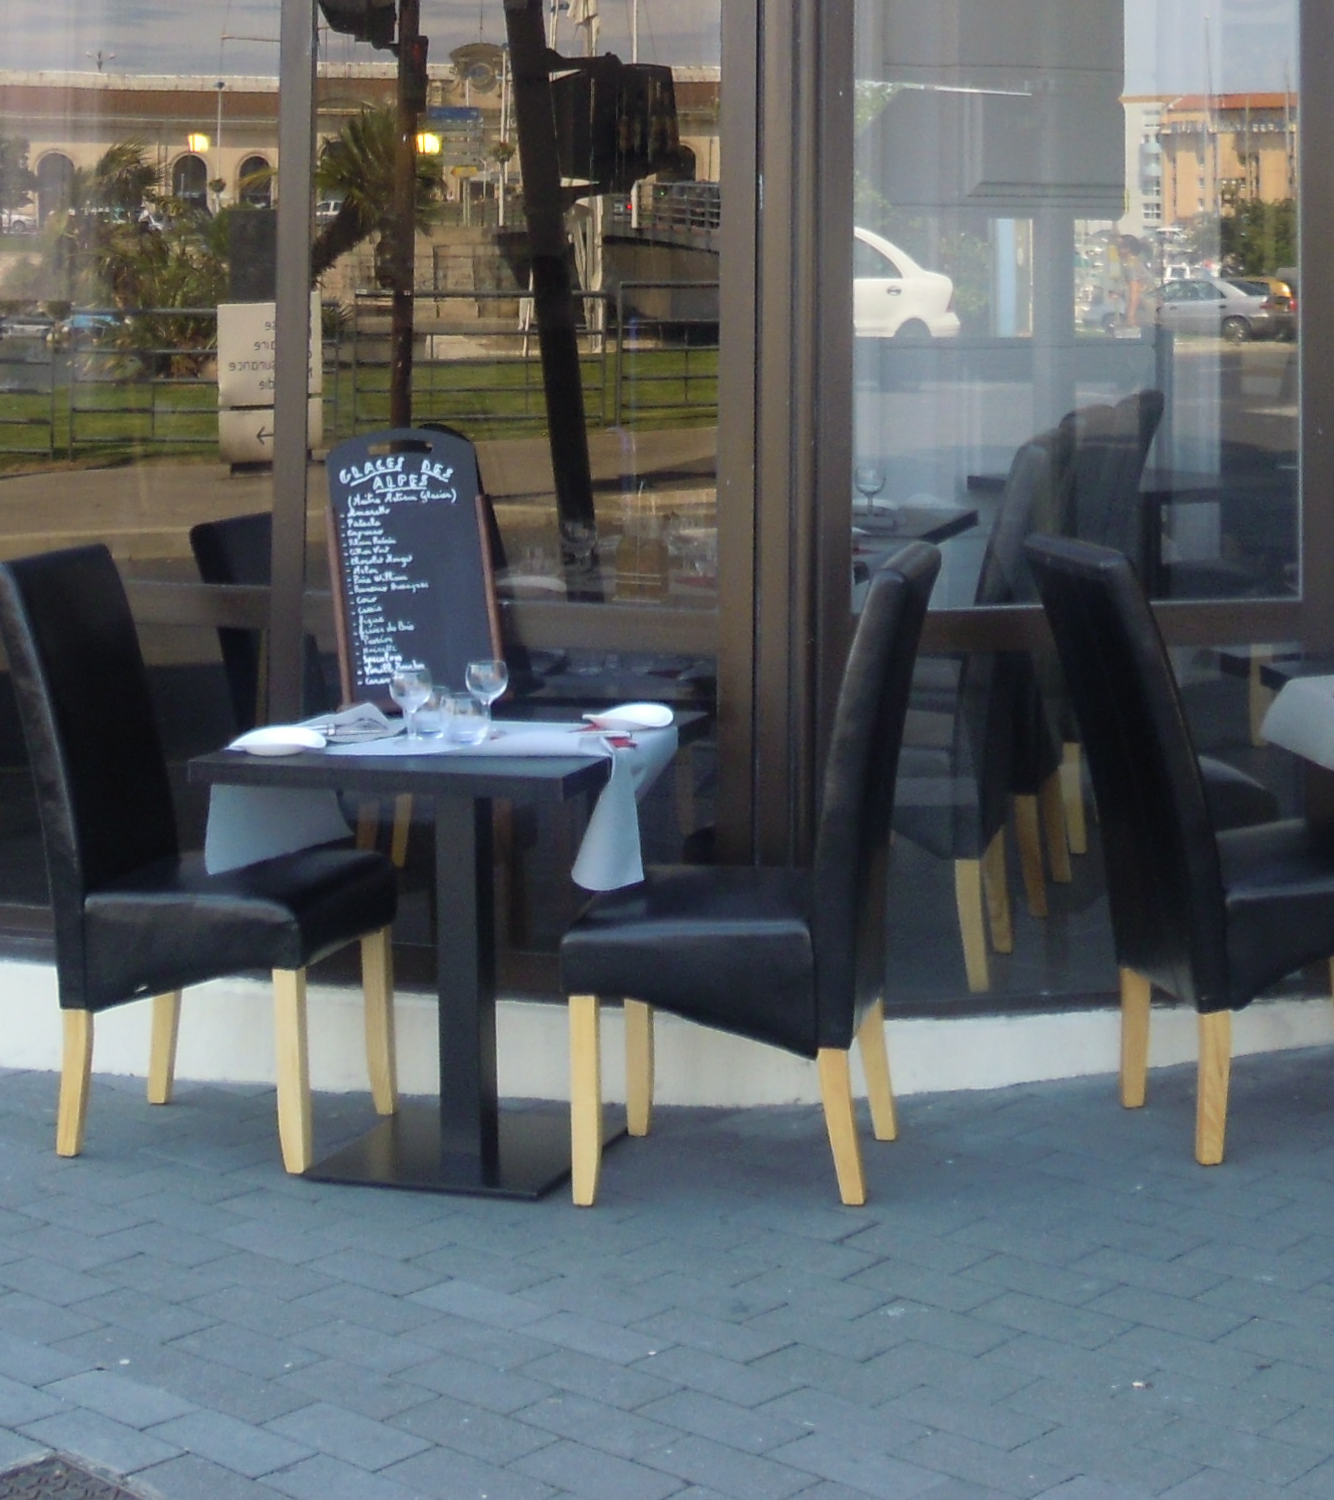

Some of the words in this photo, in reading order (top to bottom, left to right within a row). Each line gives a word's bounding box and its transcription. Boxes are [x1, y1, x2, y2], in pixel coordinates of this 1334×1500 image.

[339, 457, 405, 485] GLACES
[421, 460, 454, 479] DES
[372, 474, 429, 491] ALPES
[384, 492, 418, 503] Artisan
[420, 487, 457, 503] Glacier)
[373, 545, 390, 554] Vert
